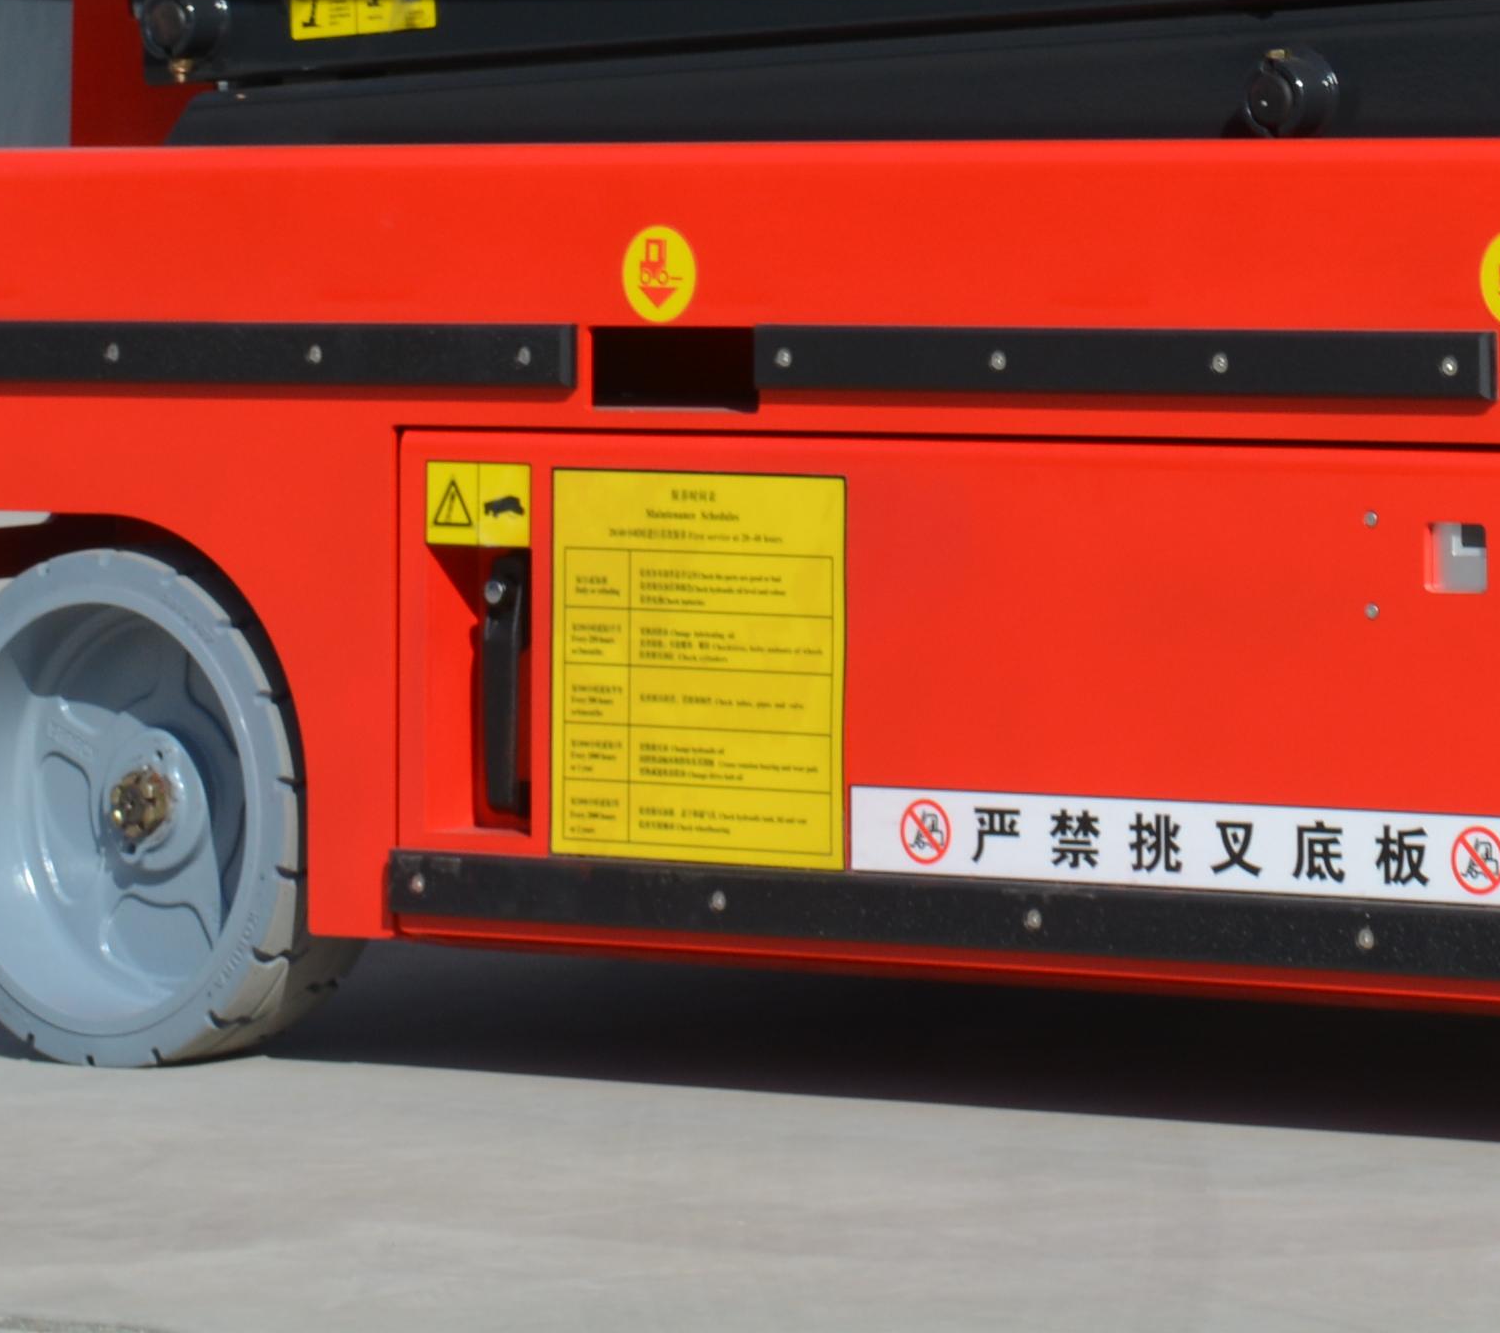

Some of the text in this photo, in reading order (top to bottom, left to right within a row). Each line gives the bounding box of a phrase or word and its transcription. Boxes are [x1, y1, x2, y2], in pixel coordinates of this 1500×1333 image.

[971, 805, 1432, 886] 严禁挑叉底板
